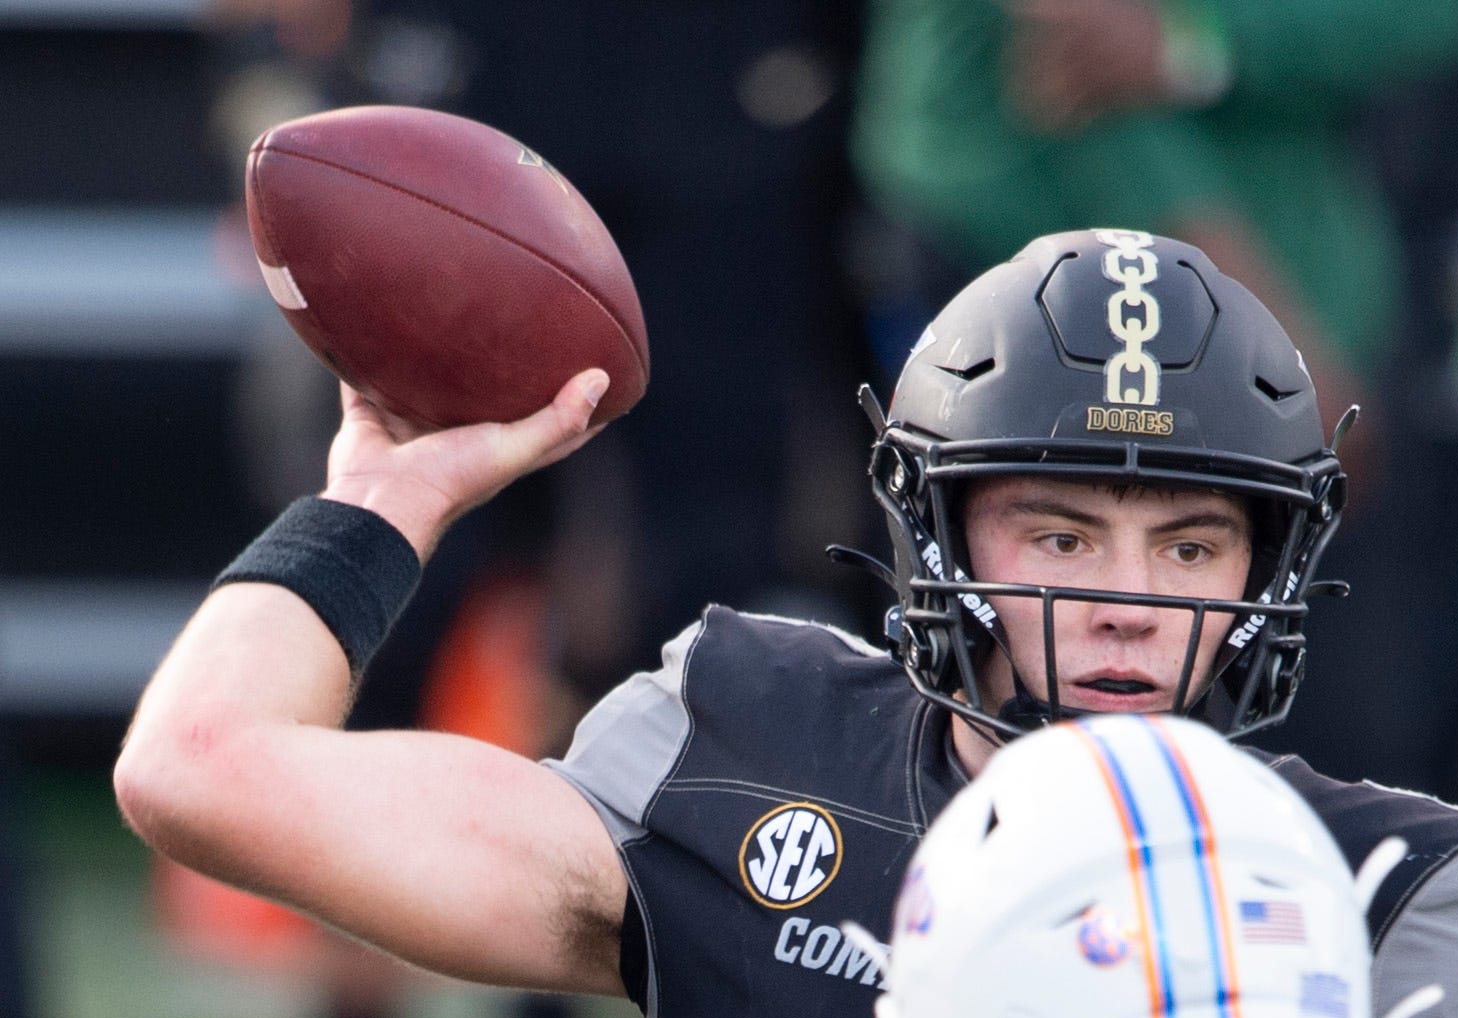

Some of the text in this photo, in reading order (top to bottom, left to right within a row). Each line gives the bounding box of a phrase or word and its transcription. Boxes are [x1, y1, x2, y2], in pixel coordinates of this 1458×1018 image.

[1086, 406, 1174, 436] DORES
[747, 809, 836, 902] SEC
[773, 916, 891, 992] COM
